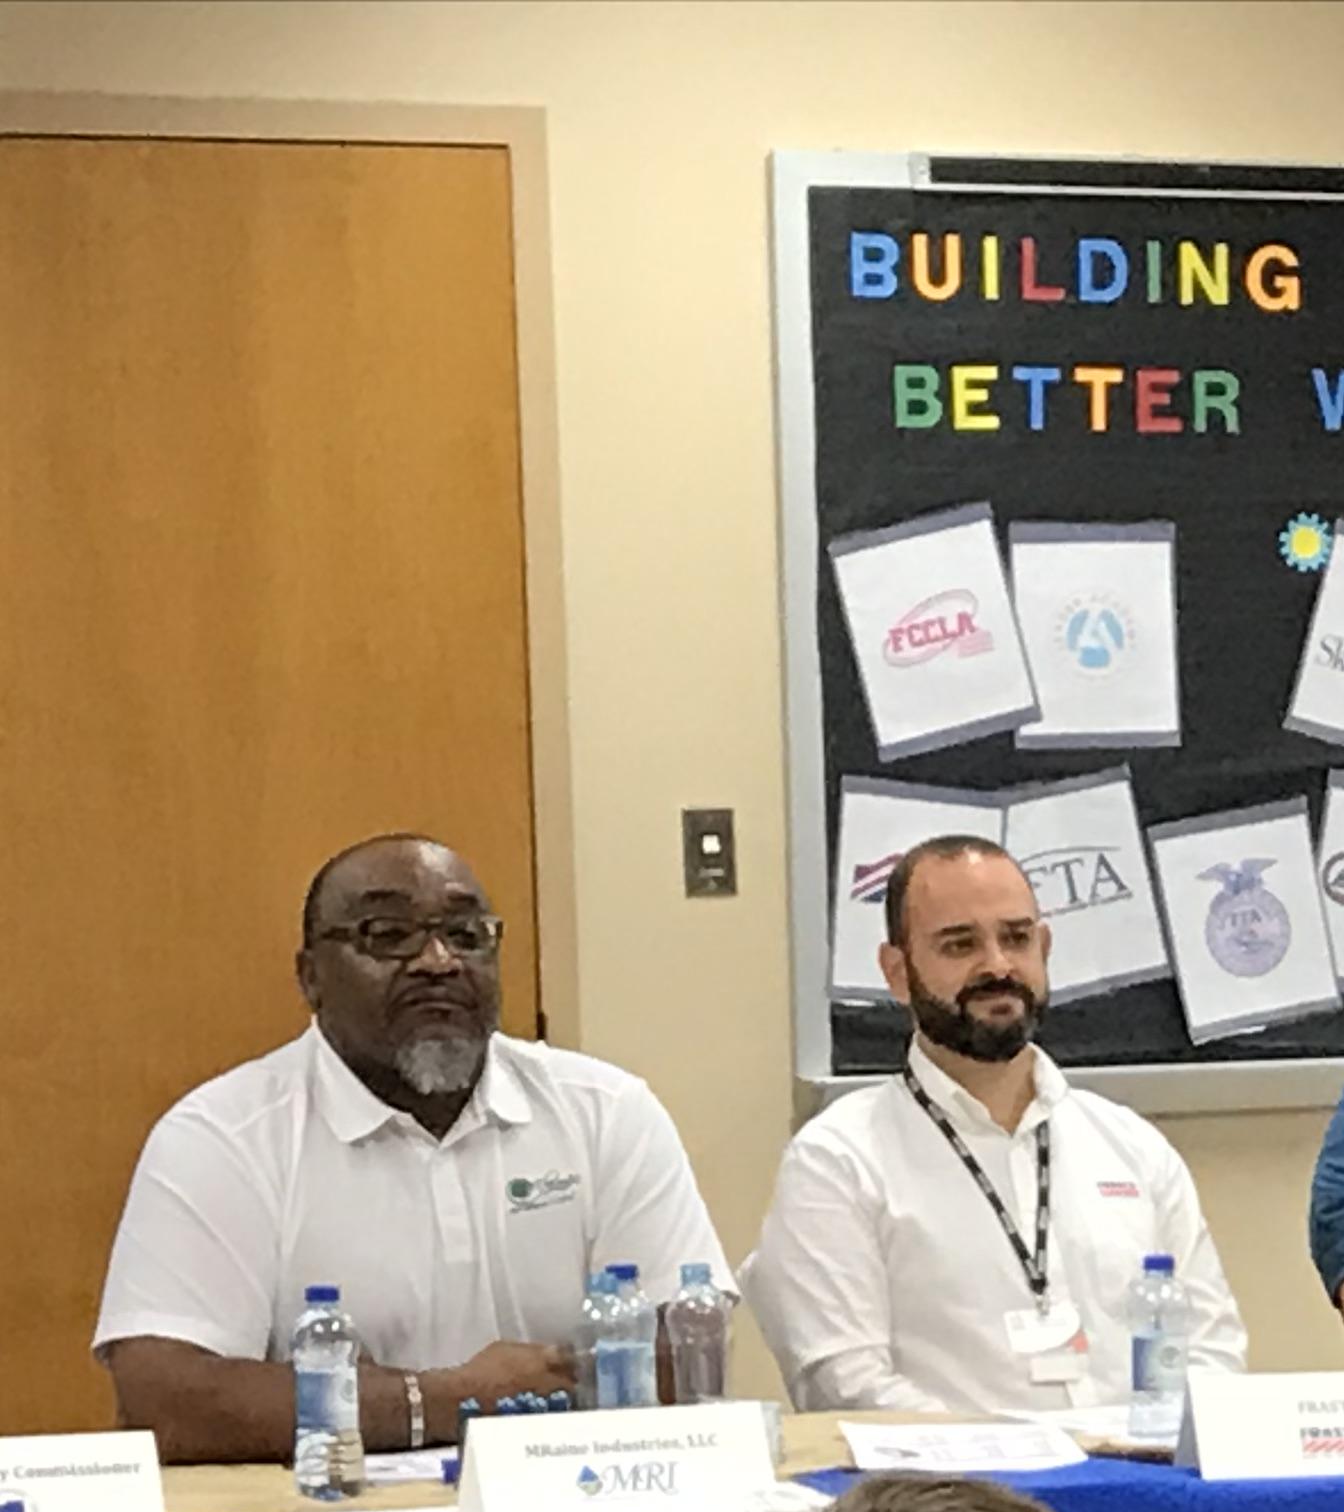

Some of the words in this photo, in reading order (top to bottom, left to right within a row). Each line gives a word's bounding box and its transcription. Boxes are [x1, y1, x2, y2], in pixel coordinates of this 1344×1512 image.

[850, 231, 1301, 312] BUILDING
[893, 364, 1241, 434] BETTER
[889, 611, 976, 653] FCCLA
[687, 1433, 718, 1448] LLC
[13, 1461, 141, 1479] Commissioner
[602, 1461, 679, 1495] MRI
